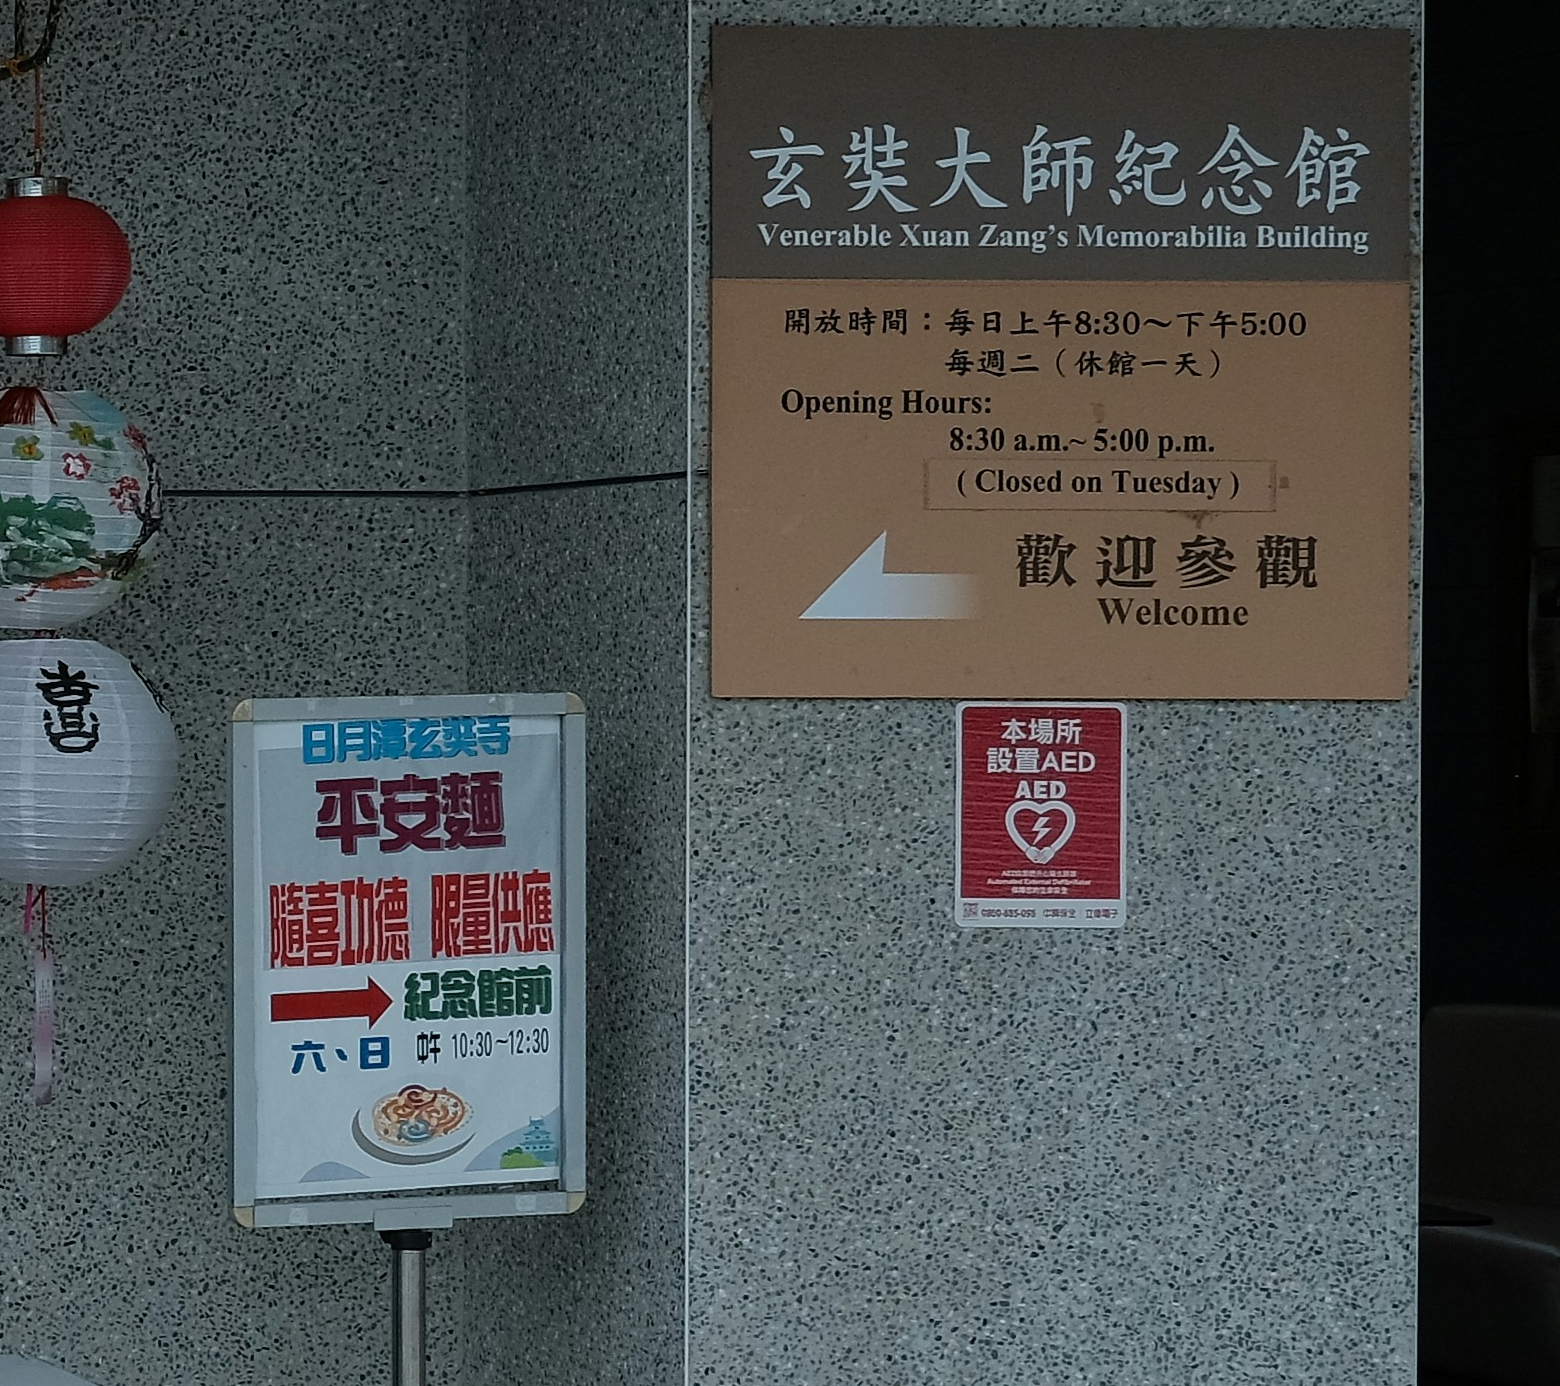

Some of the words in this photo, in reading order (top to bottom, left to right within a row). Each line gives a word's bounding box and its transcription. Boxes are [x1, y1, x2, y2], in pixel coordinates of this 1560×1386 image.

[749, 122, 1371, 217] 玄奘大師紀念館
[758, 223, 892, 248] Venerable
[899, 224, 970, 248] Xuan
[978, 224, 1069, 254] Zang's
[1077, 224, 1248, 249] Memorabilia
[1256, 225, 1370, 255] Building
[781, 391, 893, 419] Opening
[901, 390, 992, 414] Hours:
[949, 428, 1005, 452] 8:30
[1093, 428, 1149, 452] 5:00
[1157, 434, 1215, 458] p.m.
[975, 469, 1062, 494] Closed
[1071, 476, 1102, 494] on
[1111, 470, 1221, 500] Tuesday
[1015, 533, 1318, 589] 歡迎參觀
[1097, 598, 1249, 626] Welcome
[302, 715, 511, 764] 日月潭玄奘寺
[1000, 718, 1083, 745] 本場所
[986, 747, 1096, 774] 設置AED
[1015, 780, 1067, 799] AED
[316, 771, 506, 855] 平安麵
[269, 876, 411, 969] 隨喜功德
[431, 868, 555, 959] 限量供應
[403, 965, 552, 1021] 紀念館前
